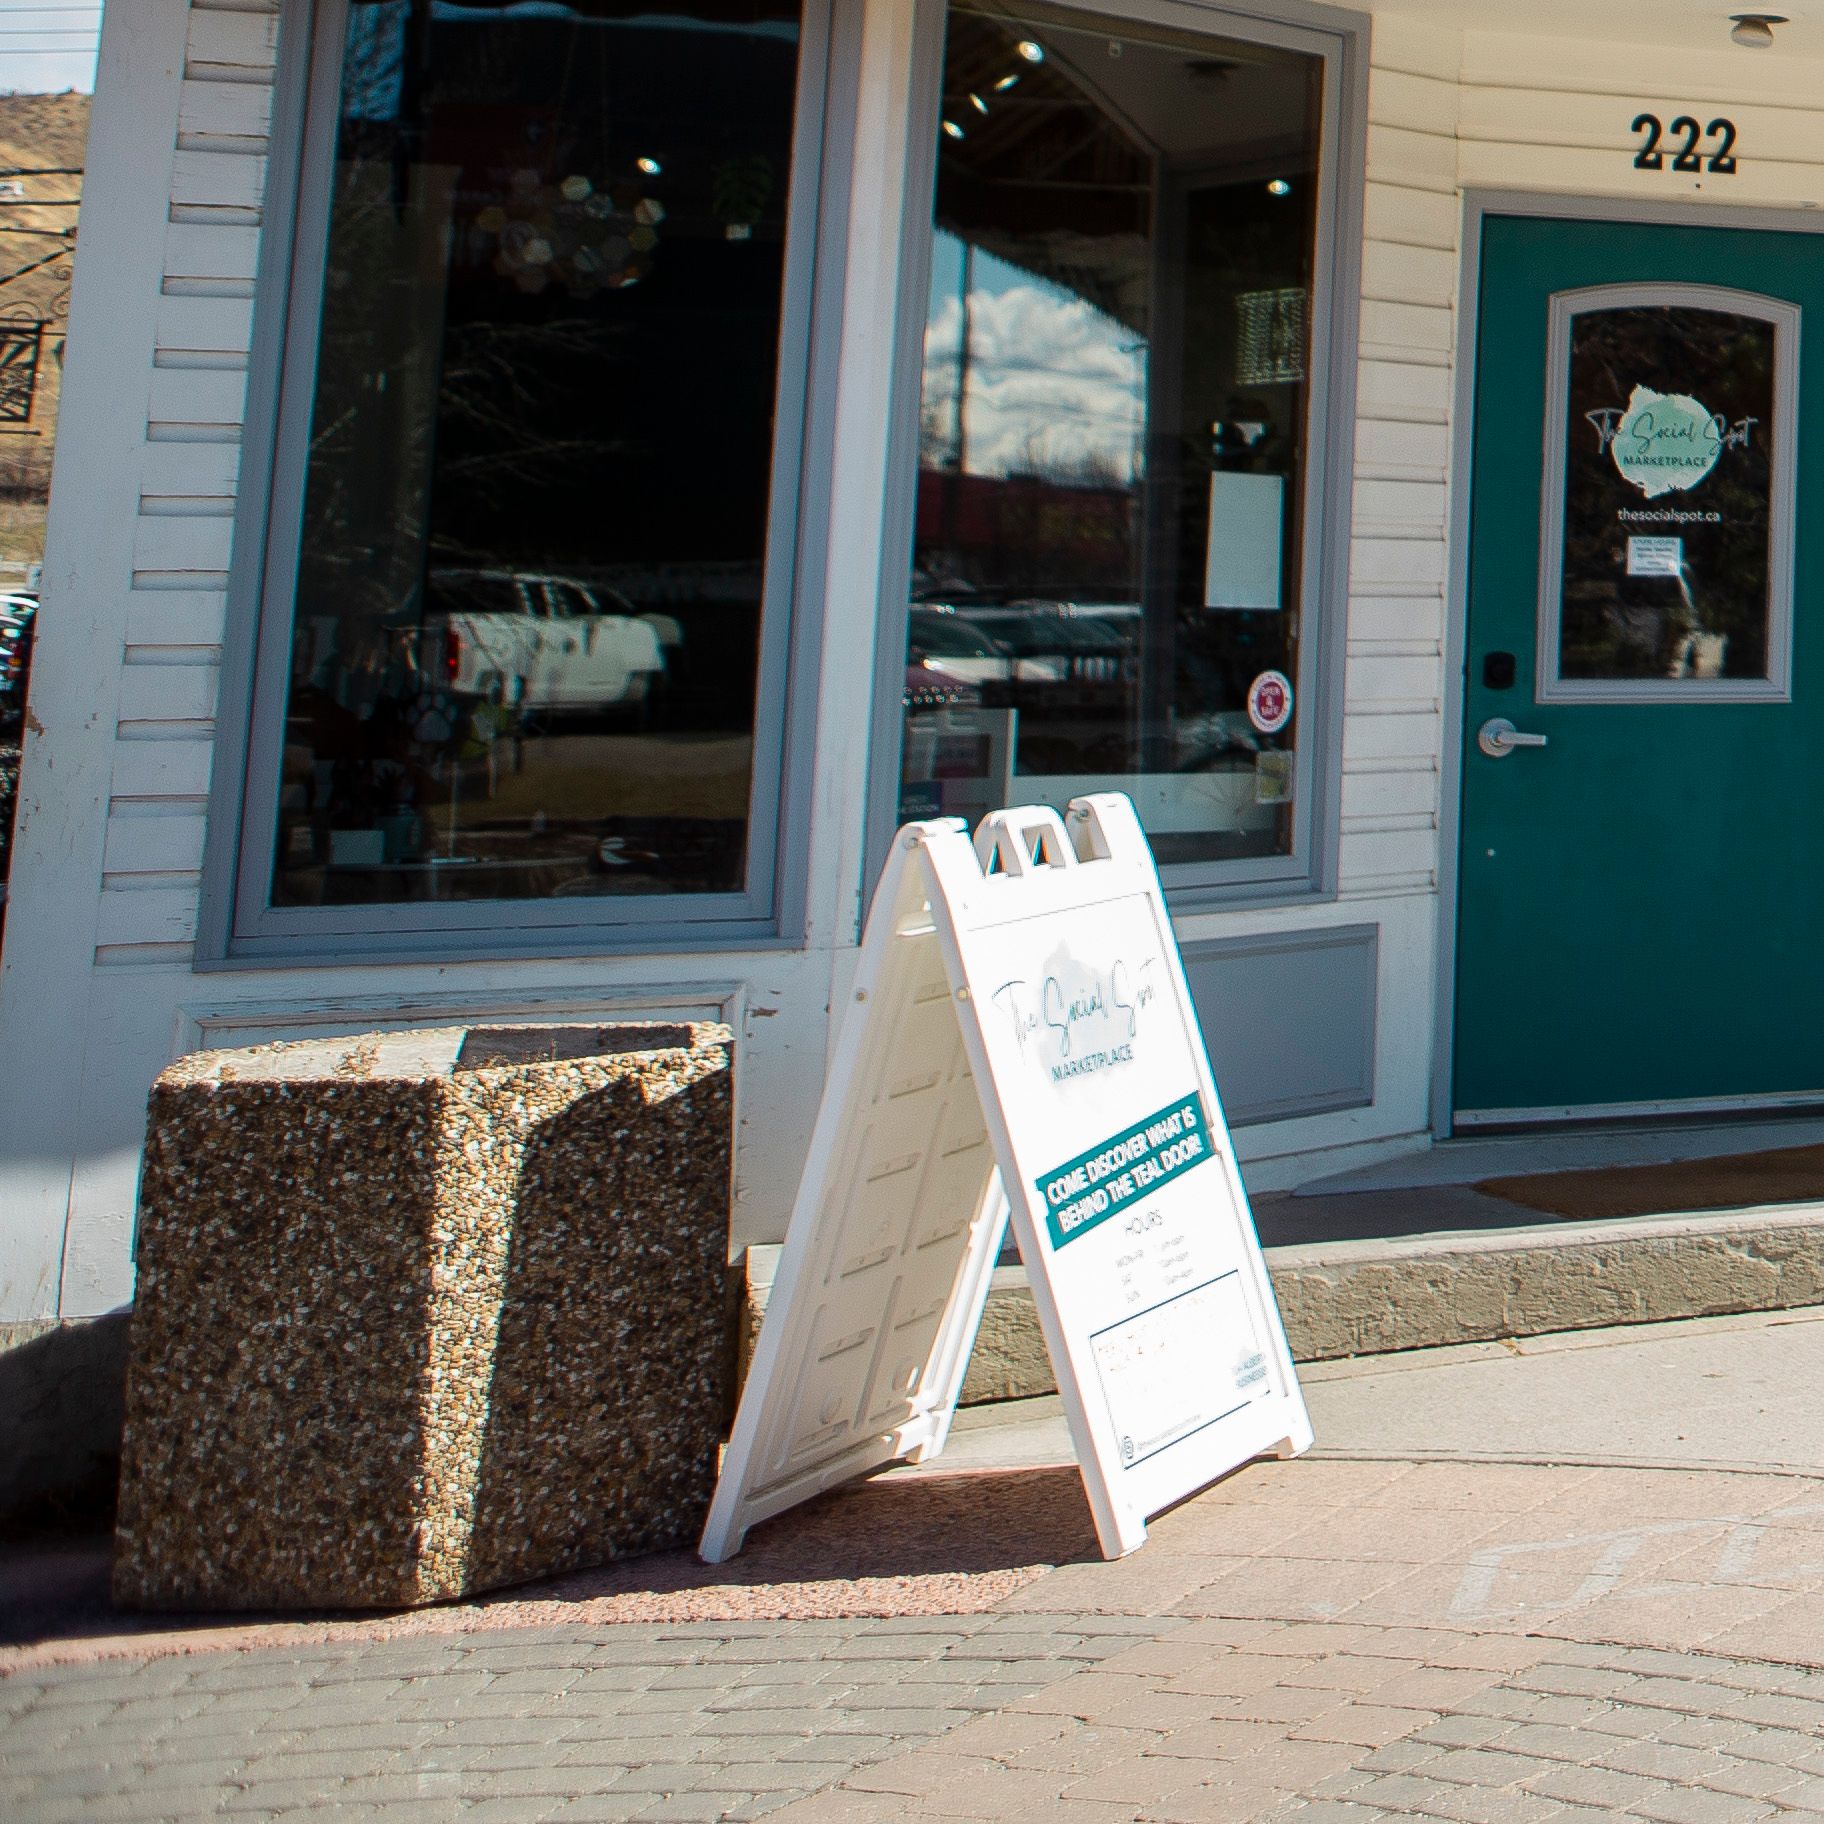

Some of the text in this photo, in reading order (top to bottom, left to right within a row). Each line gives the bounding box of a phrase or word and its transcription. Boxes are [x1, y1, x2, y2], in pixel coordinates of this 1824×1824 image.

[1630, 113, 1739, 175] 222
[1631, 411, 1696, 455] Social
[1702, 412, 1759, 457] Spot
[1623, 454, 1708, 468] MARKETPLACE
[1617, 507, 1721, 525] thesocialspot.ca
[1051, 1042, 1134, 1082] MARKETPLACE
[1046, 1105, 1197, 1206] COME DISCOVER WHAT IS
[1056, 1188, 1109, 1234] BEHIND
[1104, 1173, 1137, 1204] THE
[1130, 1156, 1167, 1189] TEAL
